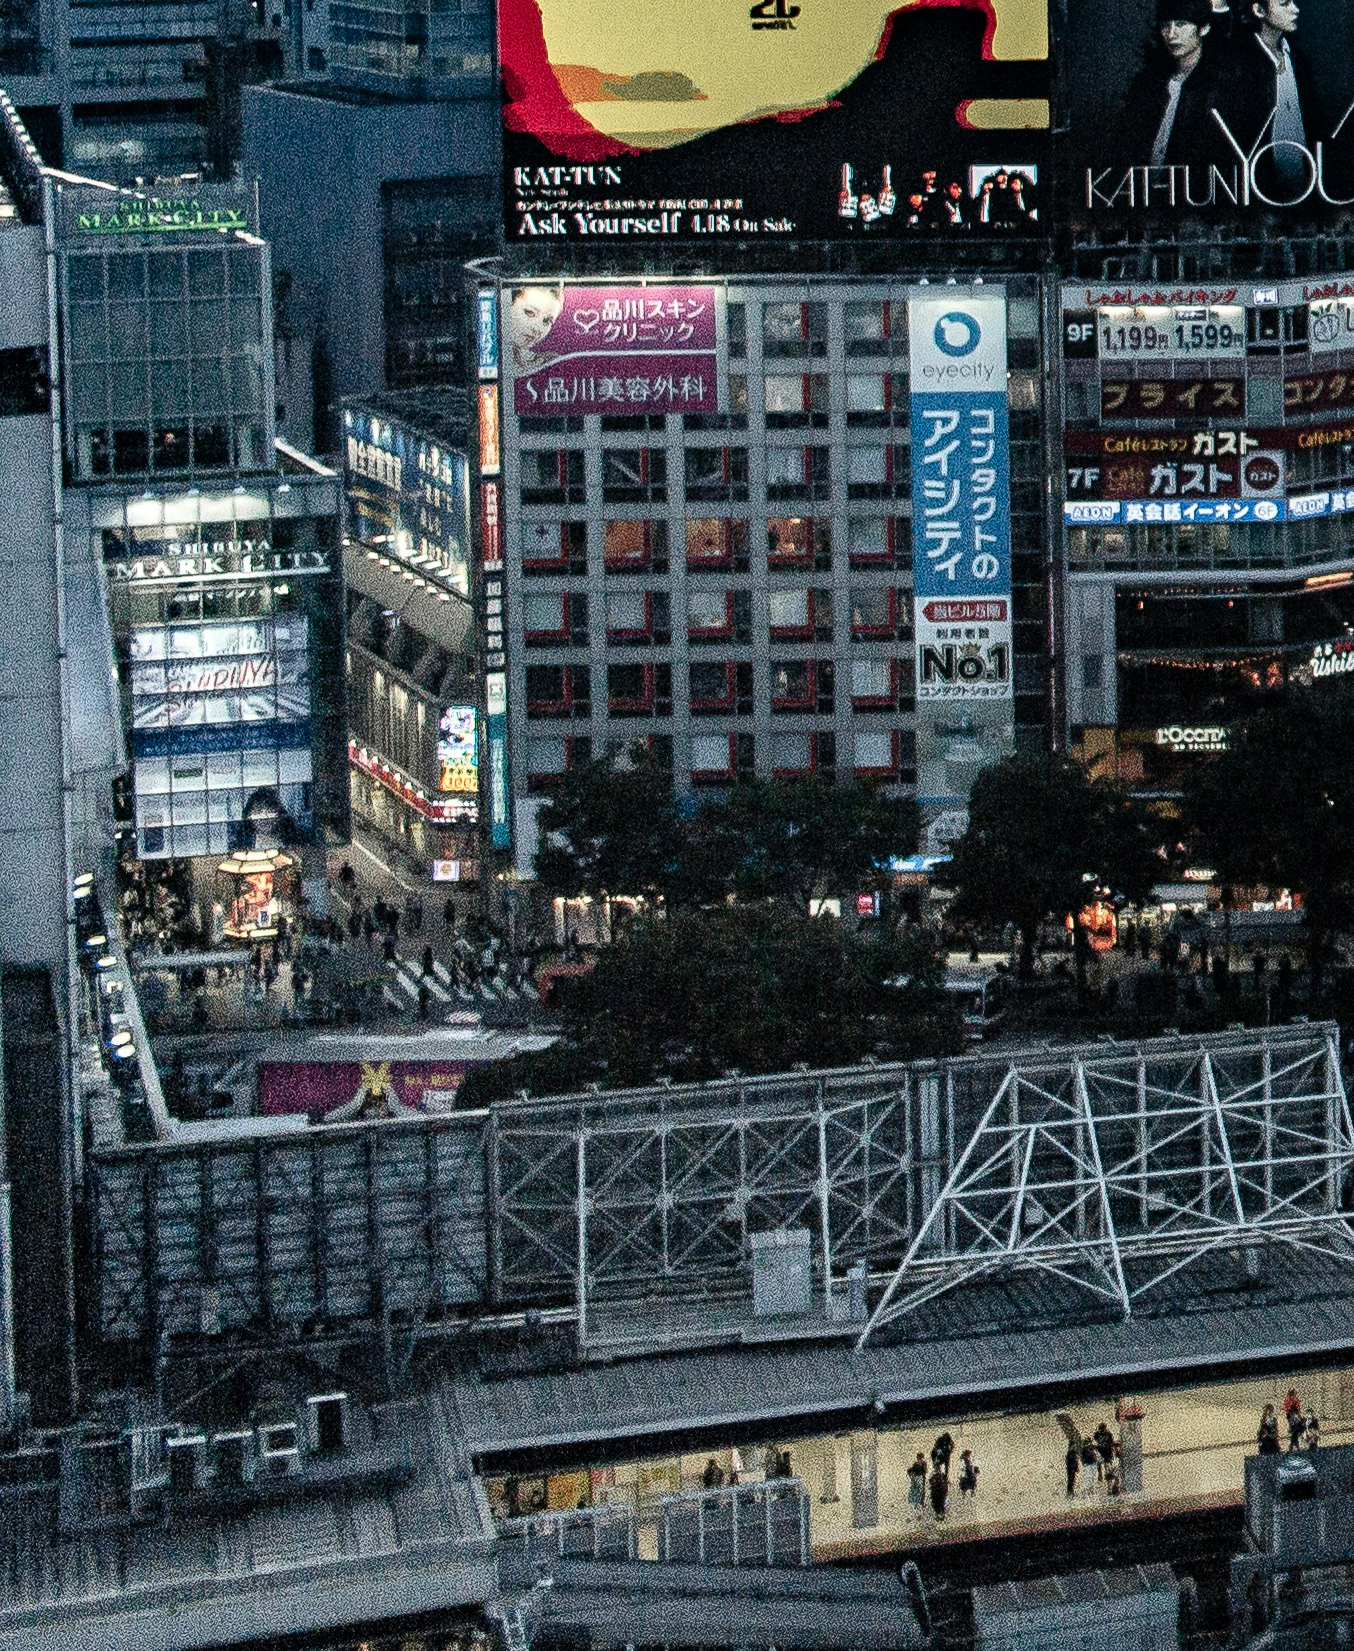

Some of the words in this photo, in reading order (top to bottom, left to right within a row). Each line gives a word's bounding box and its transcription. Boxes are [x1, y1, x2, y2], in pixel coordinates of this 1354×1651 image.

[514, 166, 622, 186] KAT-TUN
[77, 211, 164, 229] MARK
[172, 209, 243, 224] CITY
[518, 212, 567, 235] Ask
[573, 211, 682, 235] Yourself
[602, 298, 707, 322] 品川スキン
[602, 322, 695, 342] クリニック
[1067, 324, 1094, 342] 9F
[921, 360, 996, 382] eyecity
[1193, 431, 1260, 456] ガスト
[1068, 468, 1099, 488] 7F
[1150, 462, 1233, 495] ガスト
[1249, 470, 1278, 483] ガスト
[922, 409, 963, 580] アイシティ
[969, 408, 999, 580] コンタクトの
[1071, 505, 1115, 520] AEON
[1126, 502, 1249, 522] 英会話イーオン
[1294, 498, 1325, 515] AEON
[168, 539, 271, 556] SHIBUYA
[114, 556, 226, 579] MARK
[919, 643, 1010, 684] No.1
